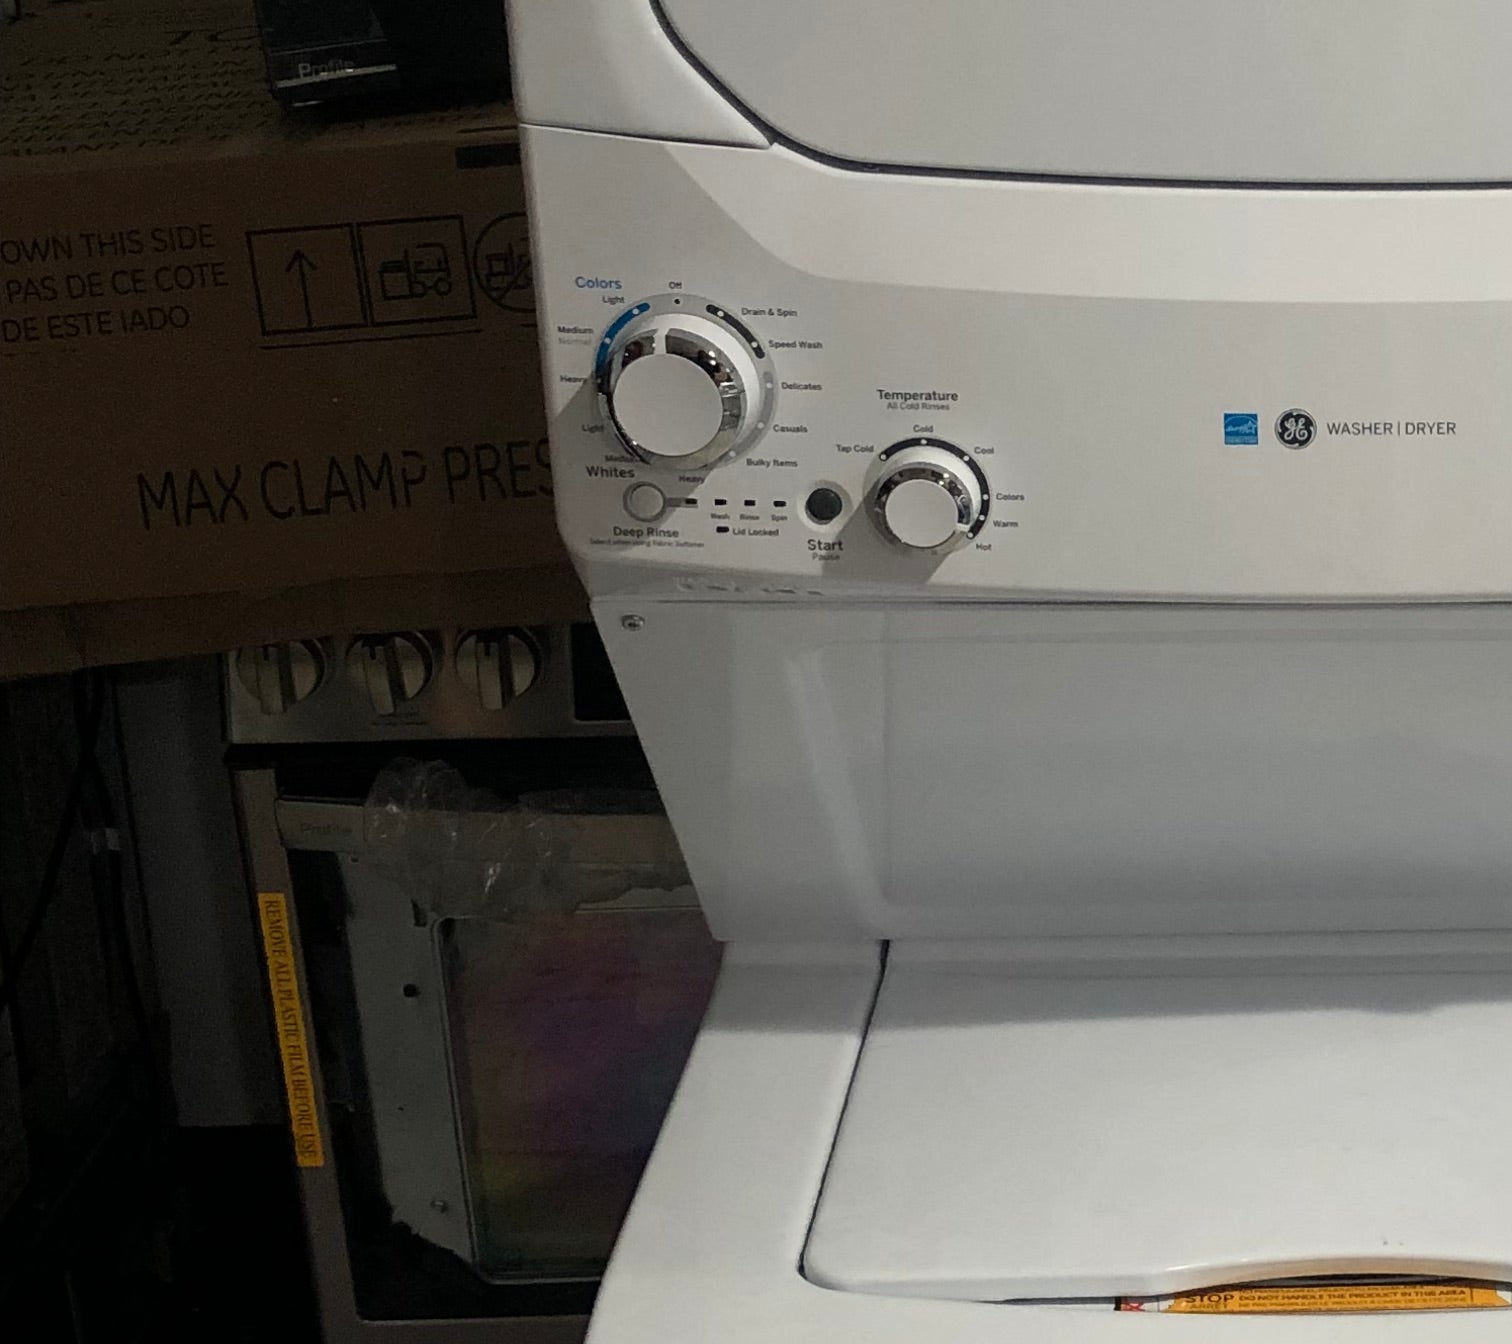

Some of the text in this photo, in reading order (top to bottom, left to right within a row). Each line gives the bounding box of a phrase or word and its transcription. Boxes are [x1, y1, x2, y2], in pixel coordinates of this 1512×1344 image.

[297, 59, 354, 78] Profile
[81, 231, 143, 257] THIS
[151, 224, 215, 252] SIDE
[6, 261, 230, 304] PAS DE CE COTE
[575, 276, 622, 290] Colors
[669, 281, 682, 290] Off
[602, 295, 625, 306] Light
[741, 307, 766, 318] Drain
[777, 308, 798, 319] Spin
[2, 317, 37, 344] DE
[47, 311, 112, 340] ESTE
[558, 326, 594, 335] Medium
[768, 340, 823, 351] Speed Wash
[781, 382, 822, 391] Delicates
[876, 389, 959, 403] Temperature
[773, 424, 808, 434] Casuals
[913, 424, 934, 434] Cold
[1326, 422, 1457, 436] WASHER DRYER
[854, 444, 875, 454] Cold
[974, 445, 995, 455] Cool
[746, 459, 772, 469] Bulky
[586, 465, 635, 479] Whites
[136, 464, 248, 532] MAX
[260, 449, 427, 521] CLAMP
[996, 492, 1025, 502] Colors
[613, 526, 680, 539] Deep Rinse
[808, 539, 844, 551] Start
[976, 542, 992, 551] Hot
[263, 899, 317, 1158] REMOVE ALL PLASTIC FILM BEFORE USE
[1185, 1293, 1235, 1304] STOP
